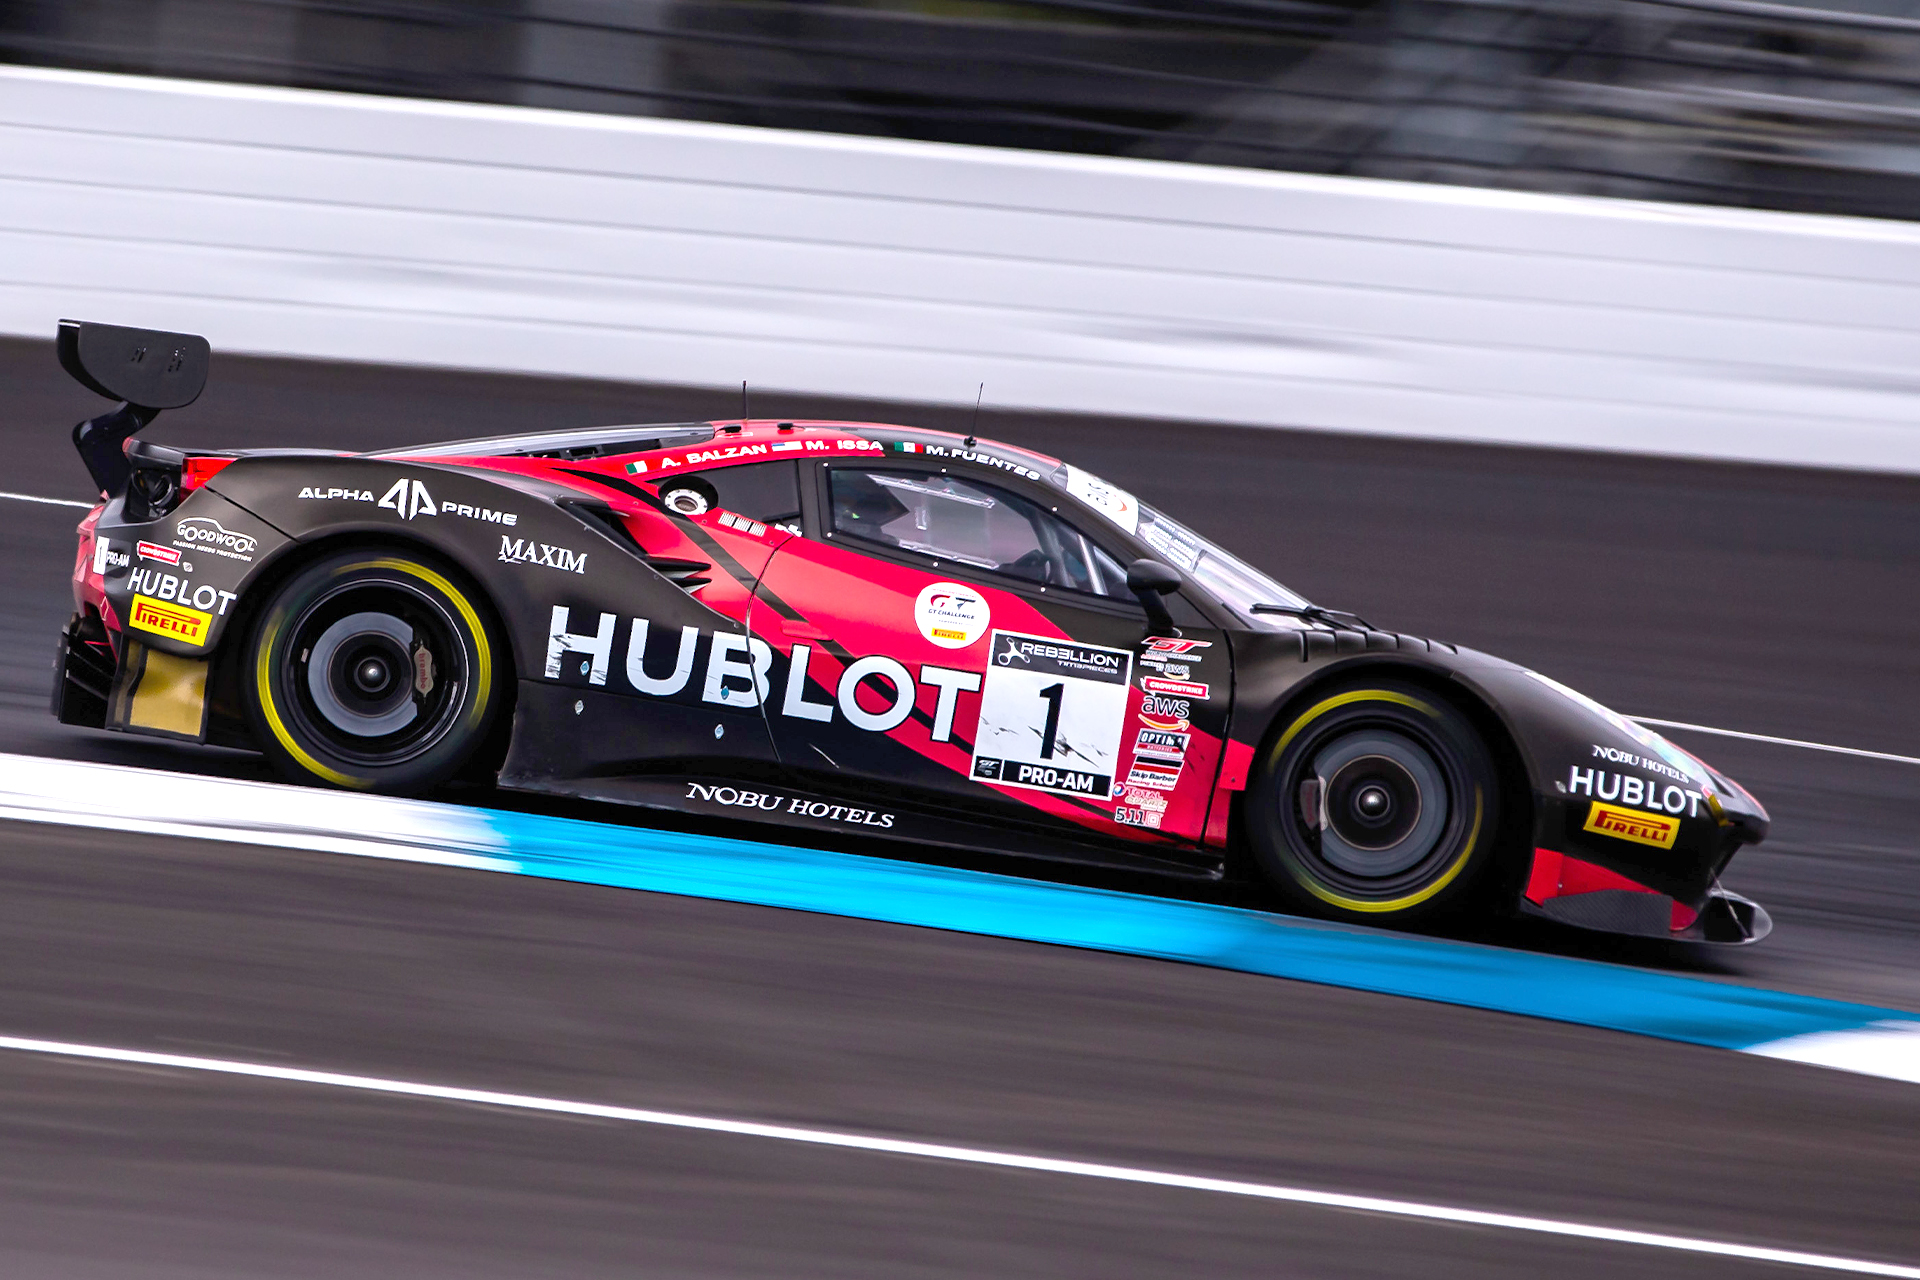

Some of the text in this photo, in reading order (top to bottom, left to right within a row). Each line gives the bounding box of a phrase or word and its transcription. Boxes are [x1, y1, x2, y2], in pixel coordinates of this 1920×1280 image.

[661, 444, 767, 469] A. BALZAN
[805, 440, 884, 451] M. ISSA
[926, 445, 1041, 481] M. FUENTES
[298, 487, 374, 502] ALPHA
[441, 501, 518, 526] PRIME
[177, 524, 255, 553] GOODWOOL
[106, 550, 130, 568] PRO-AM
[216, 549, 253, 562] PROTECTION
[498, 534, 588, 574] MAXIM
[126, 566, 238, 616] HUBLOT
[135, 602, 201, 637] PIRELLI
[937, 609, 975, 620] CHALLENGE
[1021, 642, 1119, 668] REBELLION
[418, 652, 428, 690] brembo
[544, 605, 981, 742] HUBLOT
[1149, 681, 1204, 694] CROWDSTRIKE
[1142, 695, 1190, 719] aws
[1039, 682, 1065, 760] 1
[1130, 770, 1176, 782] Skip Barber
[1592, 744, 1690, 784] NOBU HOTELS
[1018, 765, 1094, 792] PRO-AM
[1128, 778, 1175, 789] Racing School
[1569, 765, 1703, 818] HUBLOT
[1126, 786, 1160, 799] TOTAL
[685, 783, 895, 829] NOBU HOTELS
[1115, 807, 1144, 825] 5.11
[1594, 810, 1671, 843] PIRELLI
